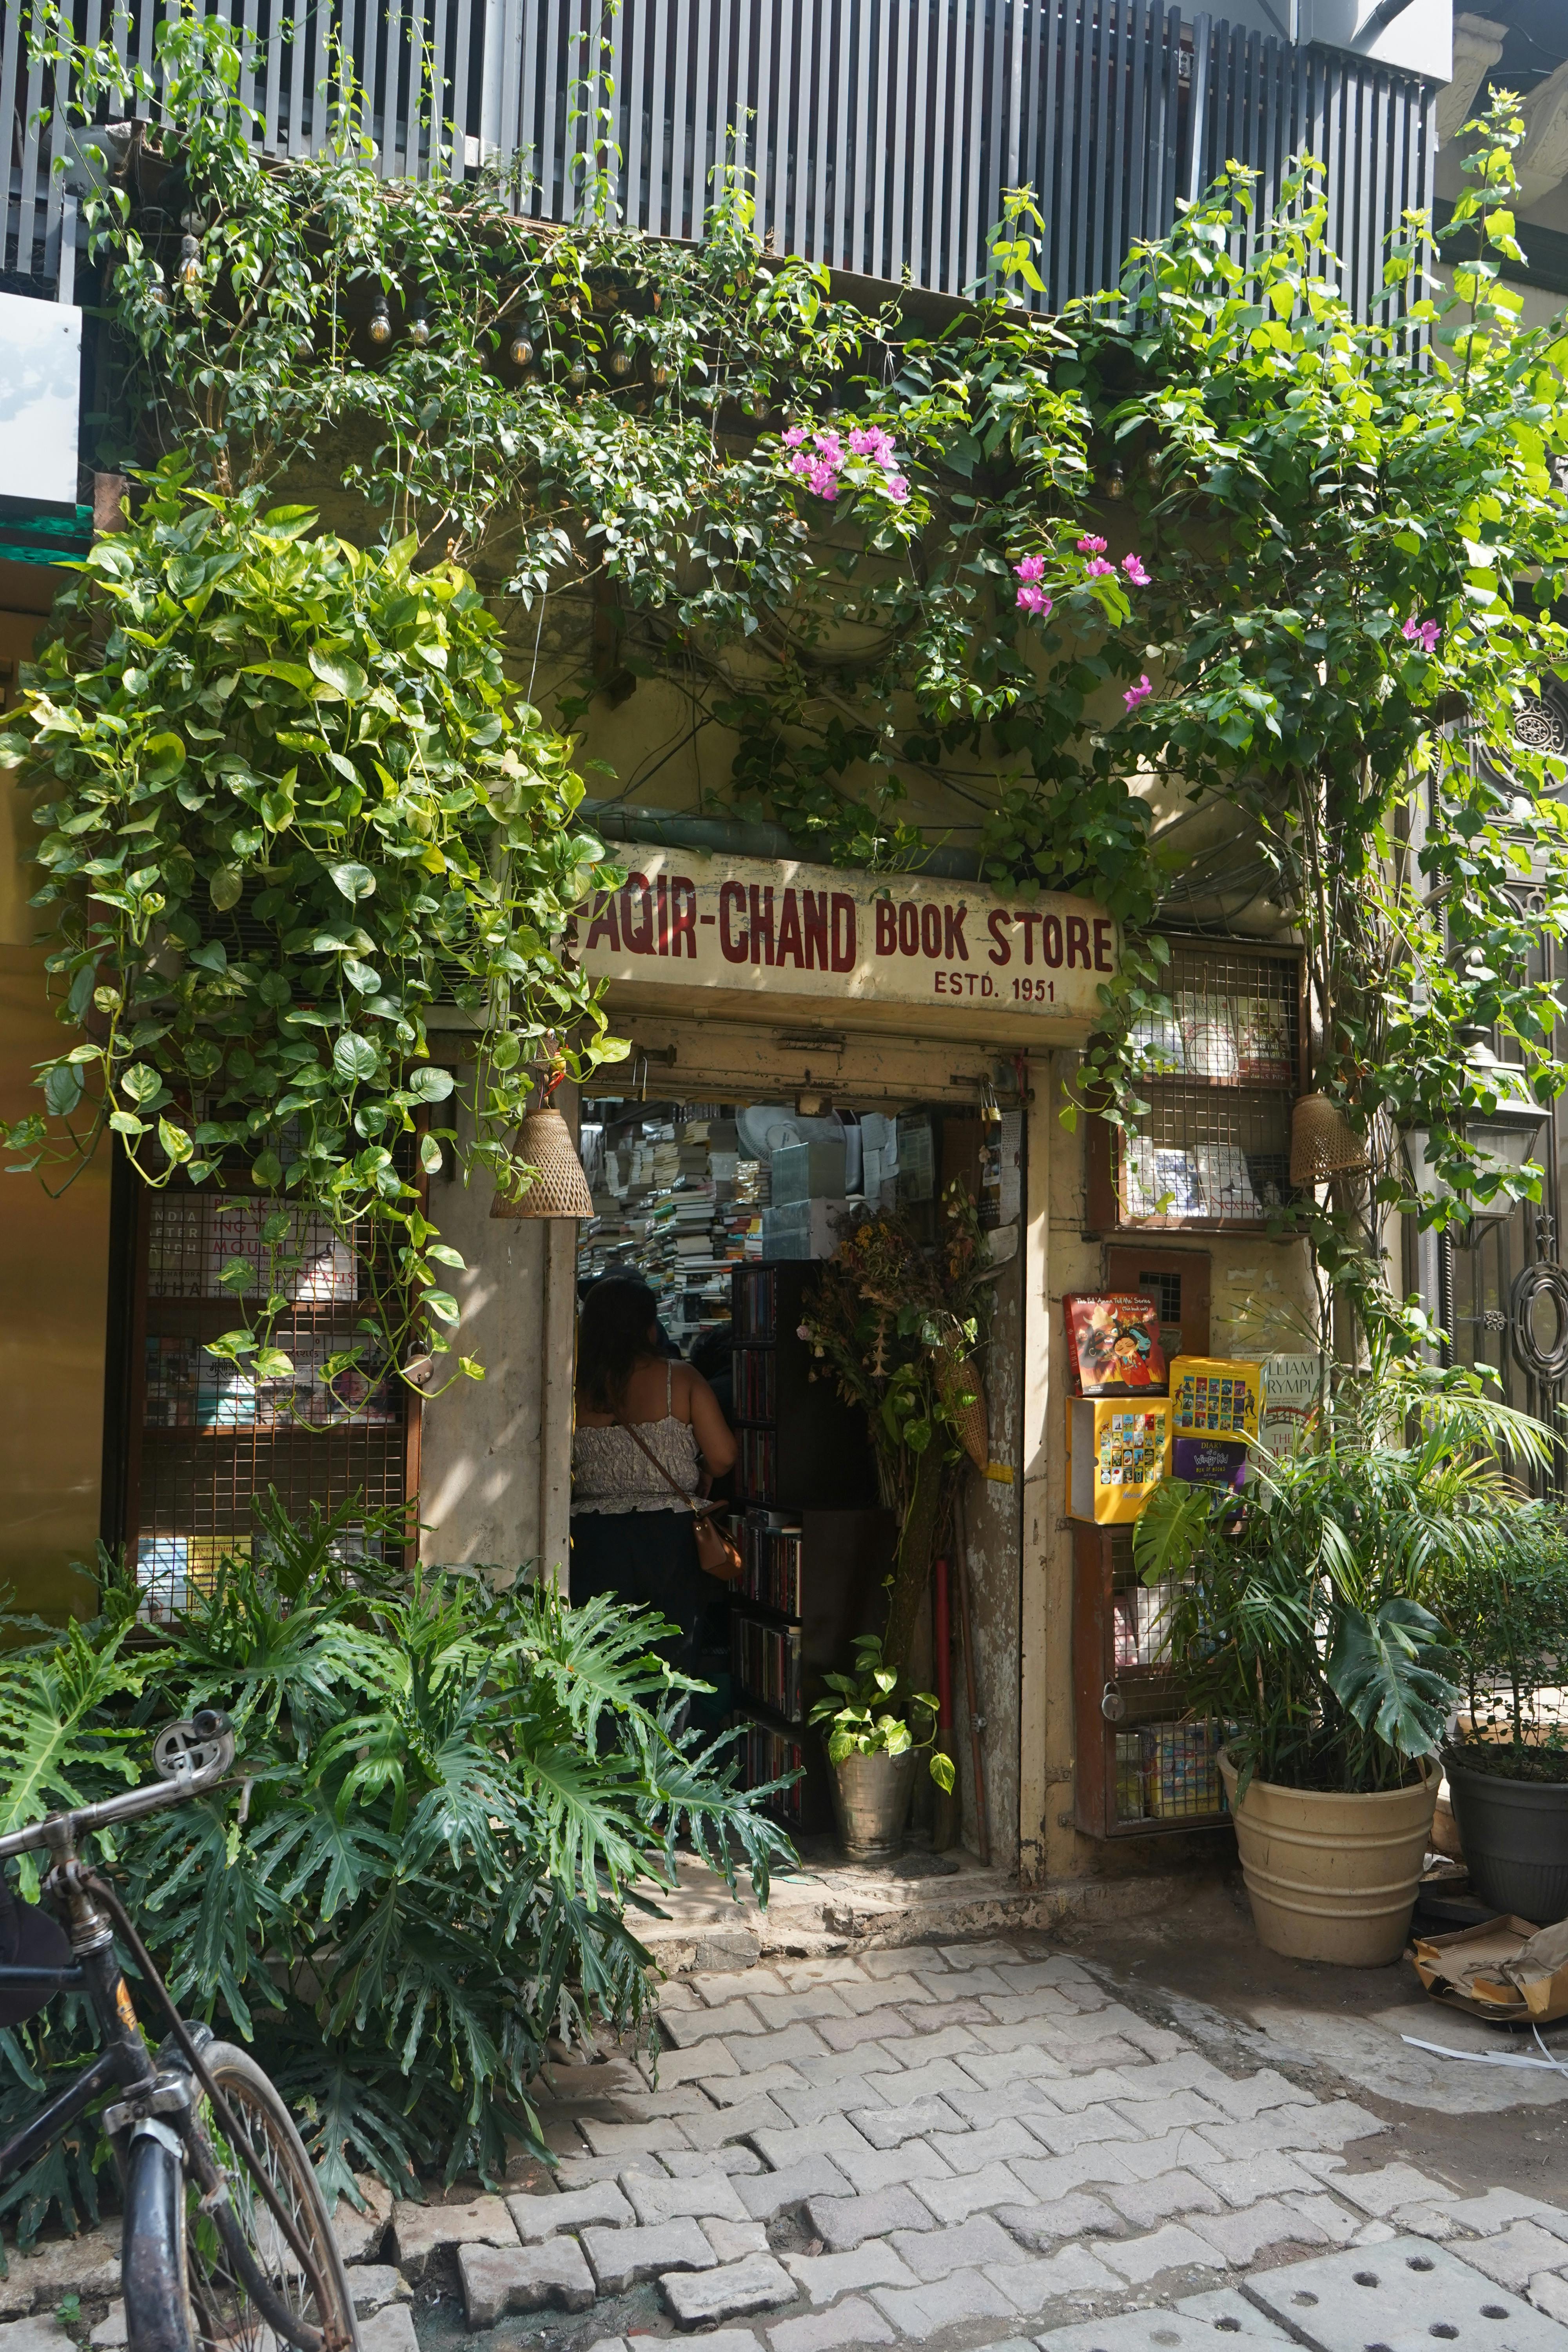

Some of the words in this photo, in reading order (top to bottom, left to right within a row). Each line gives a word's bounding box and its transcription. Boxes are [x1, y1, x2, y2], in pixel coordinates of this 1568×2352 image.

[875, 898, 969, 961] BOOK
[987, 908, 1113, 973] STORE
[935, 971, 999, 998] ESTD.
[1012, 978, 1054, 1002] 1951
[1210, 1195, 1256, 1210] Nexus
[154, 1211, 196, 1221] NDIA
[150, 1227, 198, 1238] FTER
[214, 1219, 247, 1233] ING
[290, 1263, 356, 1284] Nexus
[155, 1281, 201, 1296] UHA
[1269, 1361, 1314, 1376] LLIAM
[1268, 1379, 1319, 1394] RYMPL
[1271, 1433, 1293, 1444] THE
[1194, 1454, 1217, 1466] Wimpy
[1216, 1453, 1229, 1464] Kid
